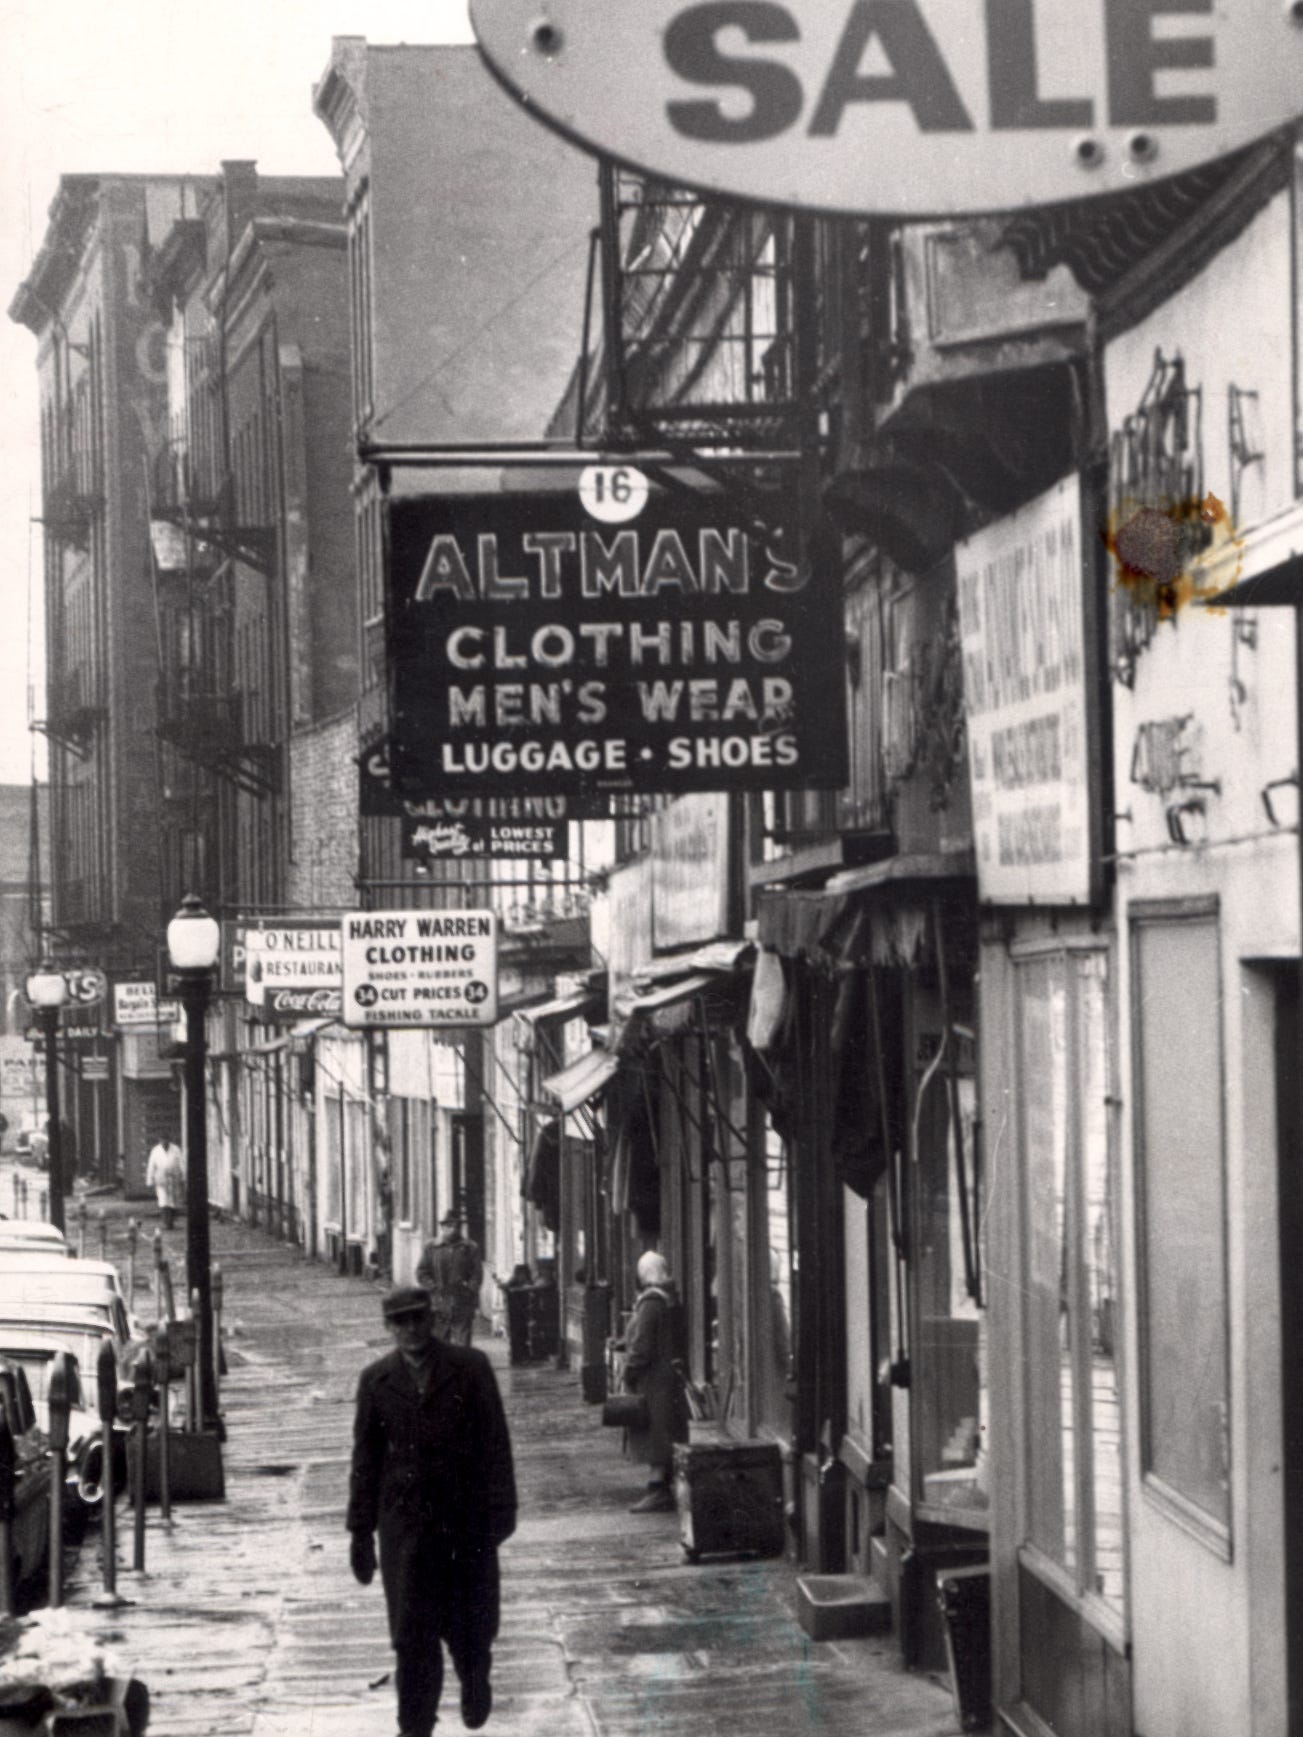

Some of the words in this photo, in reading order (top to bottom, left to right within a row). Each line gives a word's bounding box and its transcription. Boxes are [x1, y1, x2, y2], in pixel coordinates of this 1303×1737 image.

[662, 0, 1217, 144] SALE
[594, 470, 632, 504] 16
[446, 618, 792, 670] CLOTHING
[448, 680, 608, 727] MEN'S
[638, 677, 793, 723] WEAR
[442, 739, 627, 773] LUGGAGE
[668, 735, 799, 769] SHOES
[490, 826, 555, 840] LOWEST
[490, 840, 555, 854] PRICES
[350, 918, 407, 939] HARRY
[416, 917, 491, 937] WARREN
[365, 944, 476, 964] CLOTHING
[381, 988, 408, 1001] CUT
[413, 986, 462, 1000] PRICES
[365, 1009, 422, 1021] FISHING
[429, 1008, 480, 1020] TACKLE
